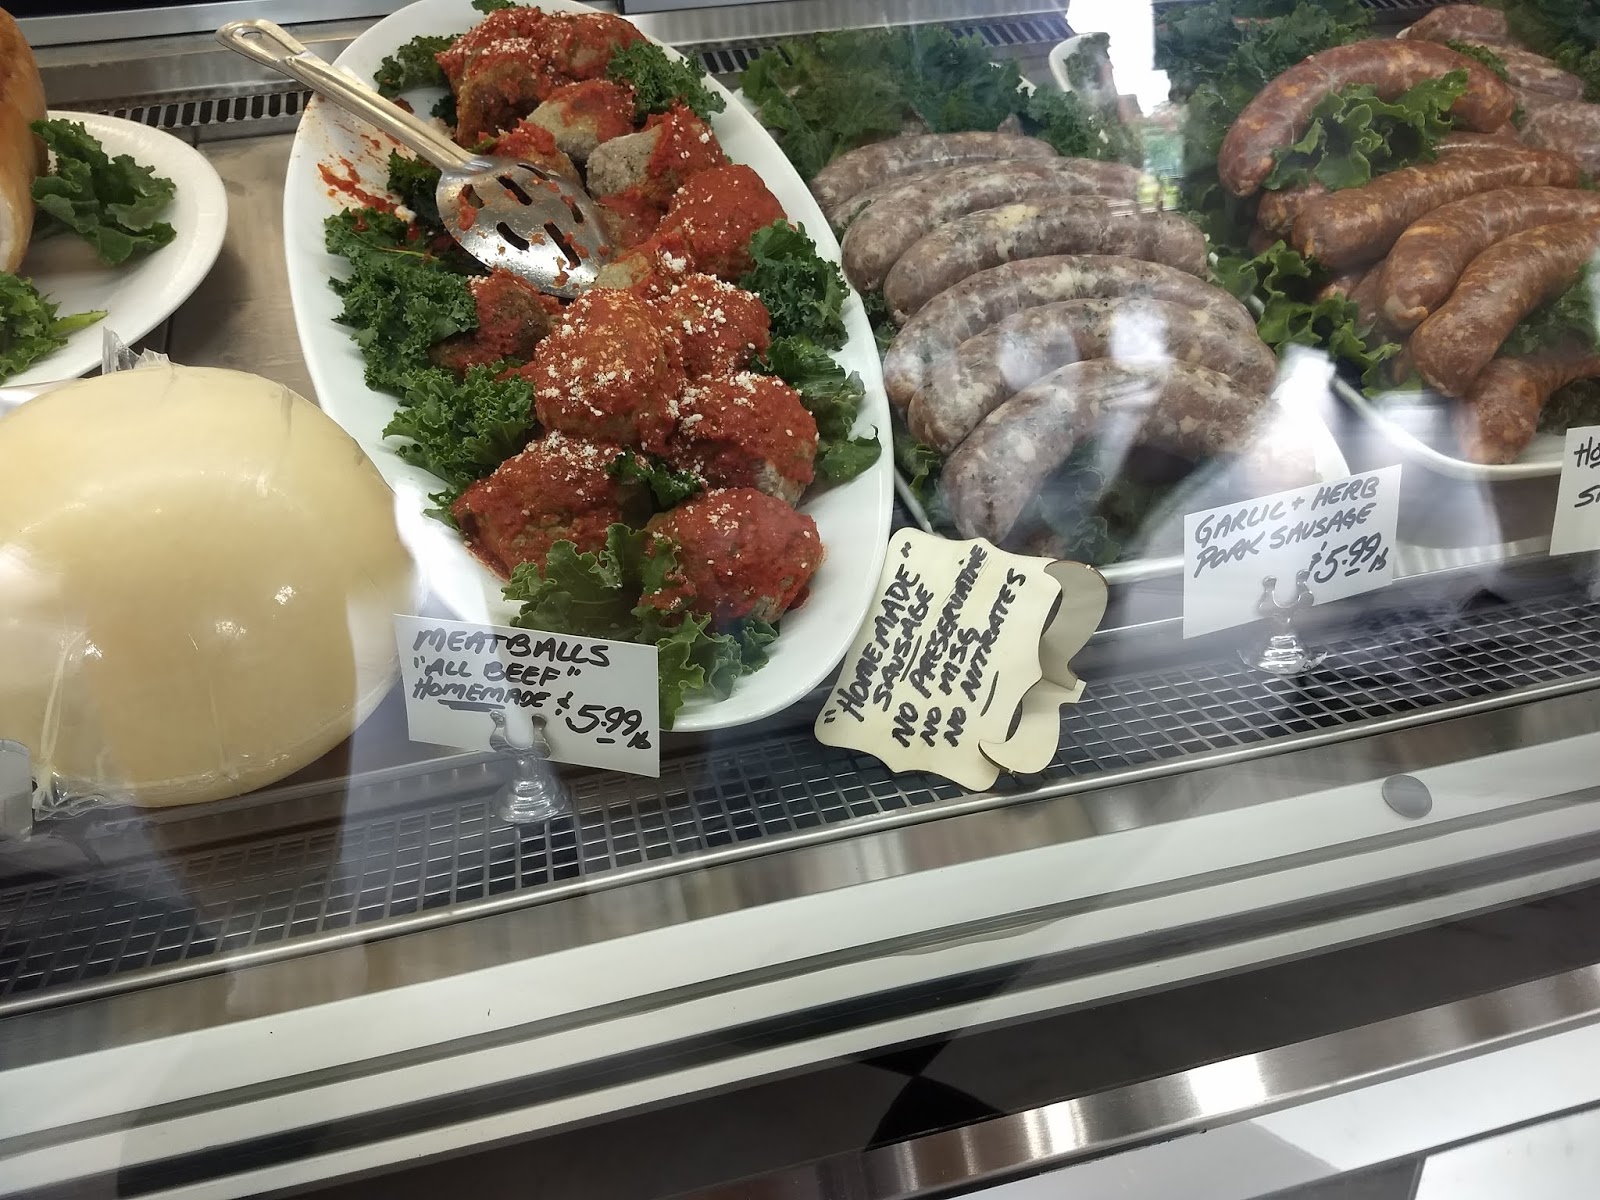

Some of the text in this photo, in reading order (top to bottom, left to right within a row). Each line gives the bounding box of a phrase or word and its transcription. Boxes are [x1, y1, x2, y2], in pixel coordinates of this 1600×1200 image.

[1195, 476, 1380, 548] GARLIC + HERB
[1574, 485, 1600, 508] S
[1193, 502, 1377, 578] PORK SAUSAGE
[412, 627, 610, 667] MEATBALLS
[873, 582, 934, 712] SAUSAGE
[943, 567, 1026, 748] NO NITRATES
[412, 677, 552, 708] HOMEMADE
[920, 627, 981, 747] NO MSG
[892, 702, 919, 748] NO
